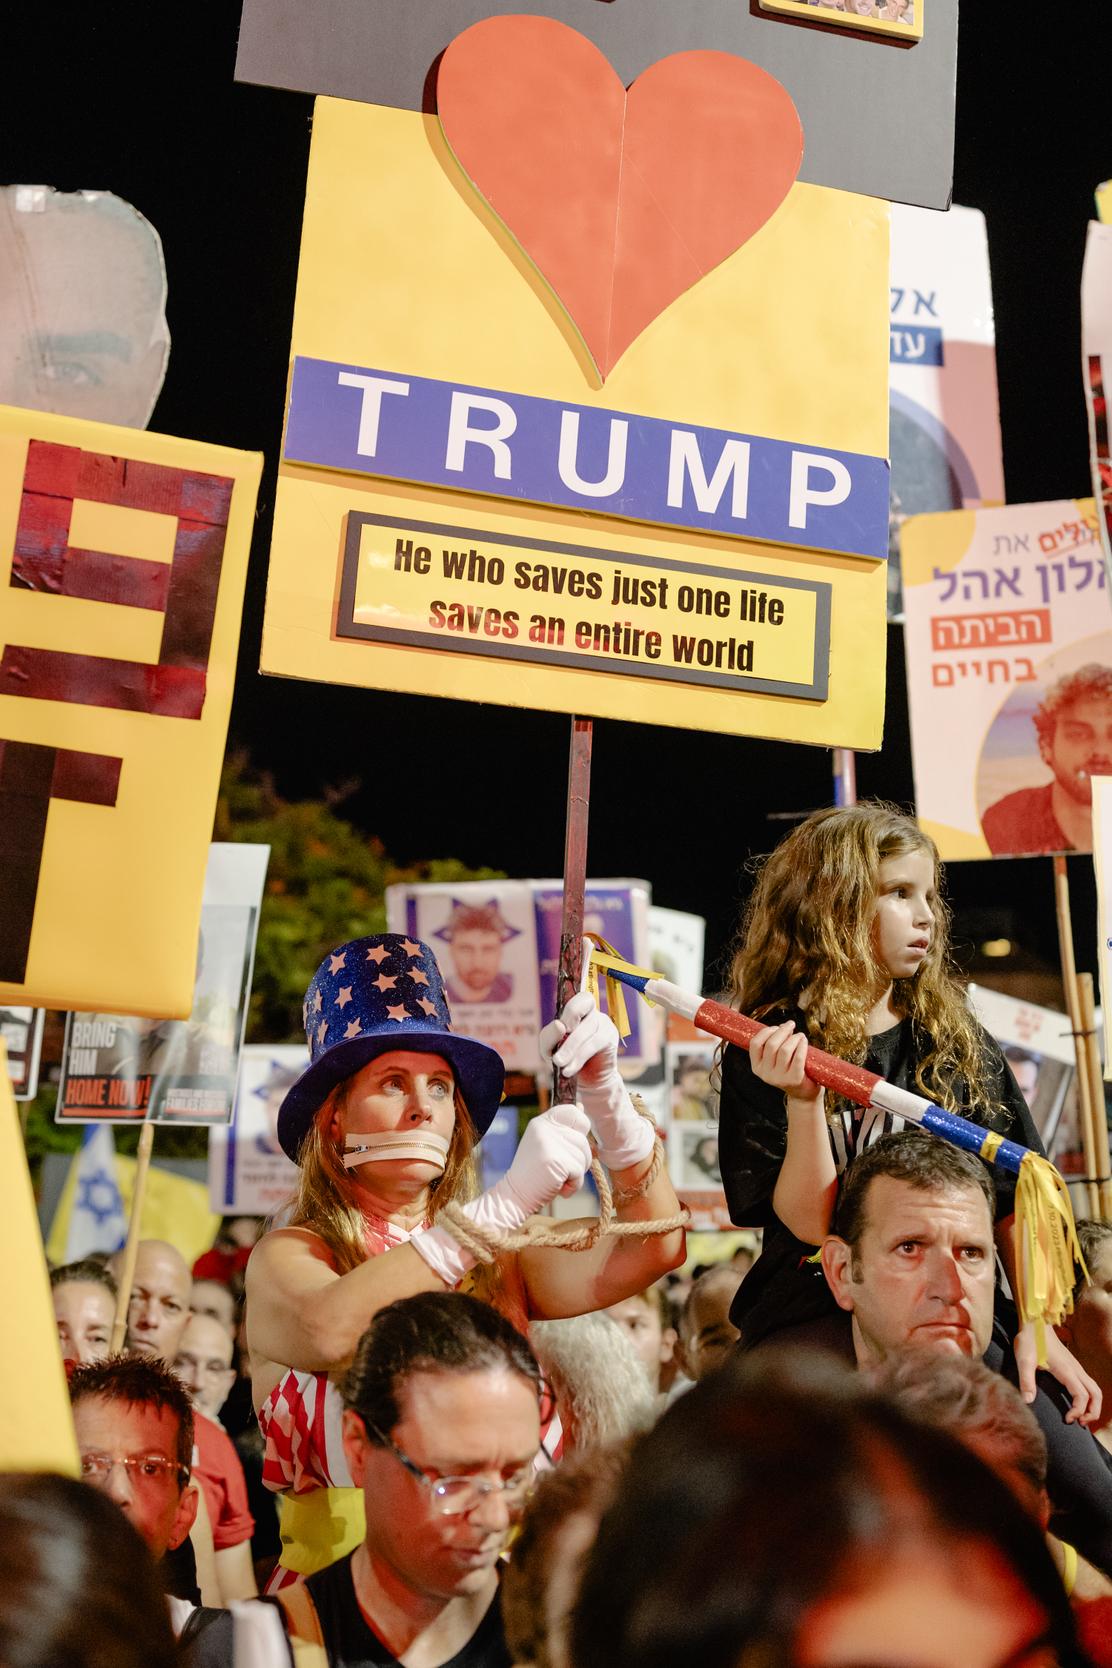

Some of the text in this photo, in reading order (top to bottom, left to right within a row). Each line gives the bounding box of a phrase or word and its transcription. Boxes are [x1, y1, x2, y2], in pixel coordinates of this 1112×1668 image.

[337, 371, 852, 529] TRUMP
[993, 534, 1031, 556] את
[394, 539, 784, 626] He who saves just one life
[932, 566, 1024, 602] אהל
[429, 600, 755, 672] saves an entire world
[937, 614, 1041, 646] הביתה
[932, 657, 1037, 687] בחיים
[72, 1022, 117, 1048] BRING
[69, 1049, 98, 1075] HIM
[66, 1079, 107, 1106] HOME
